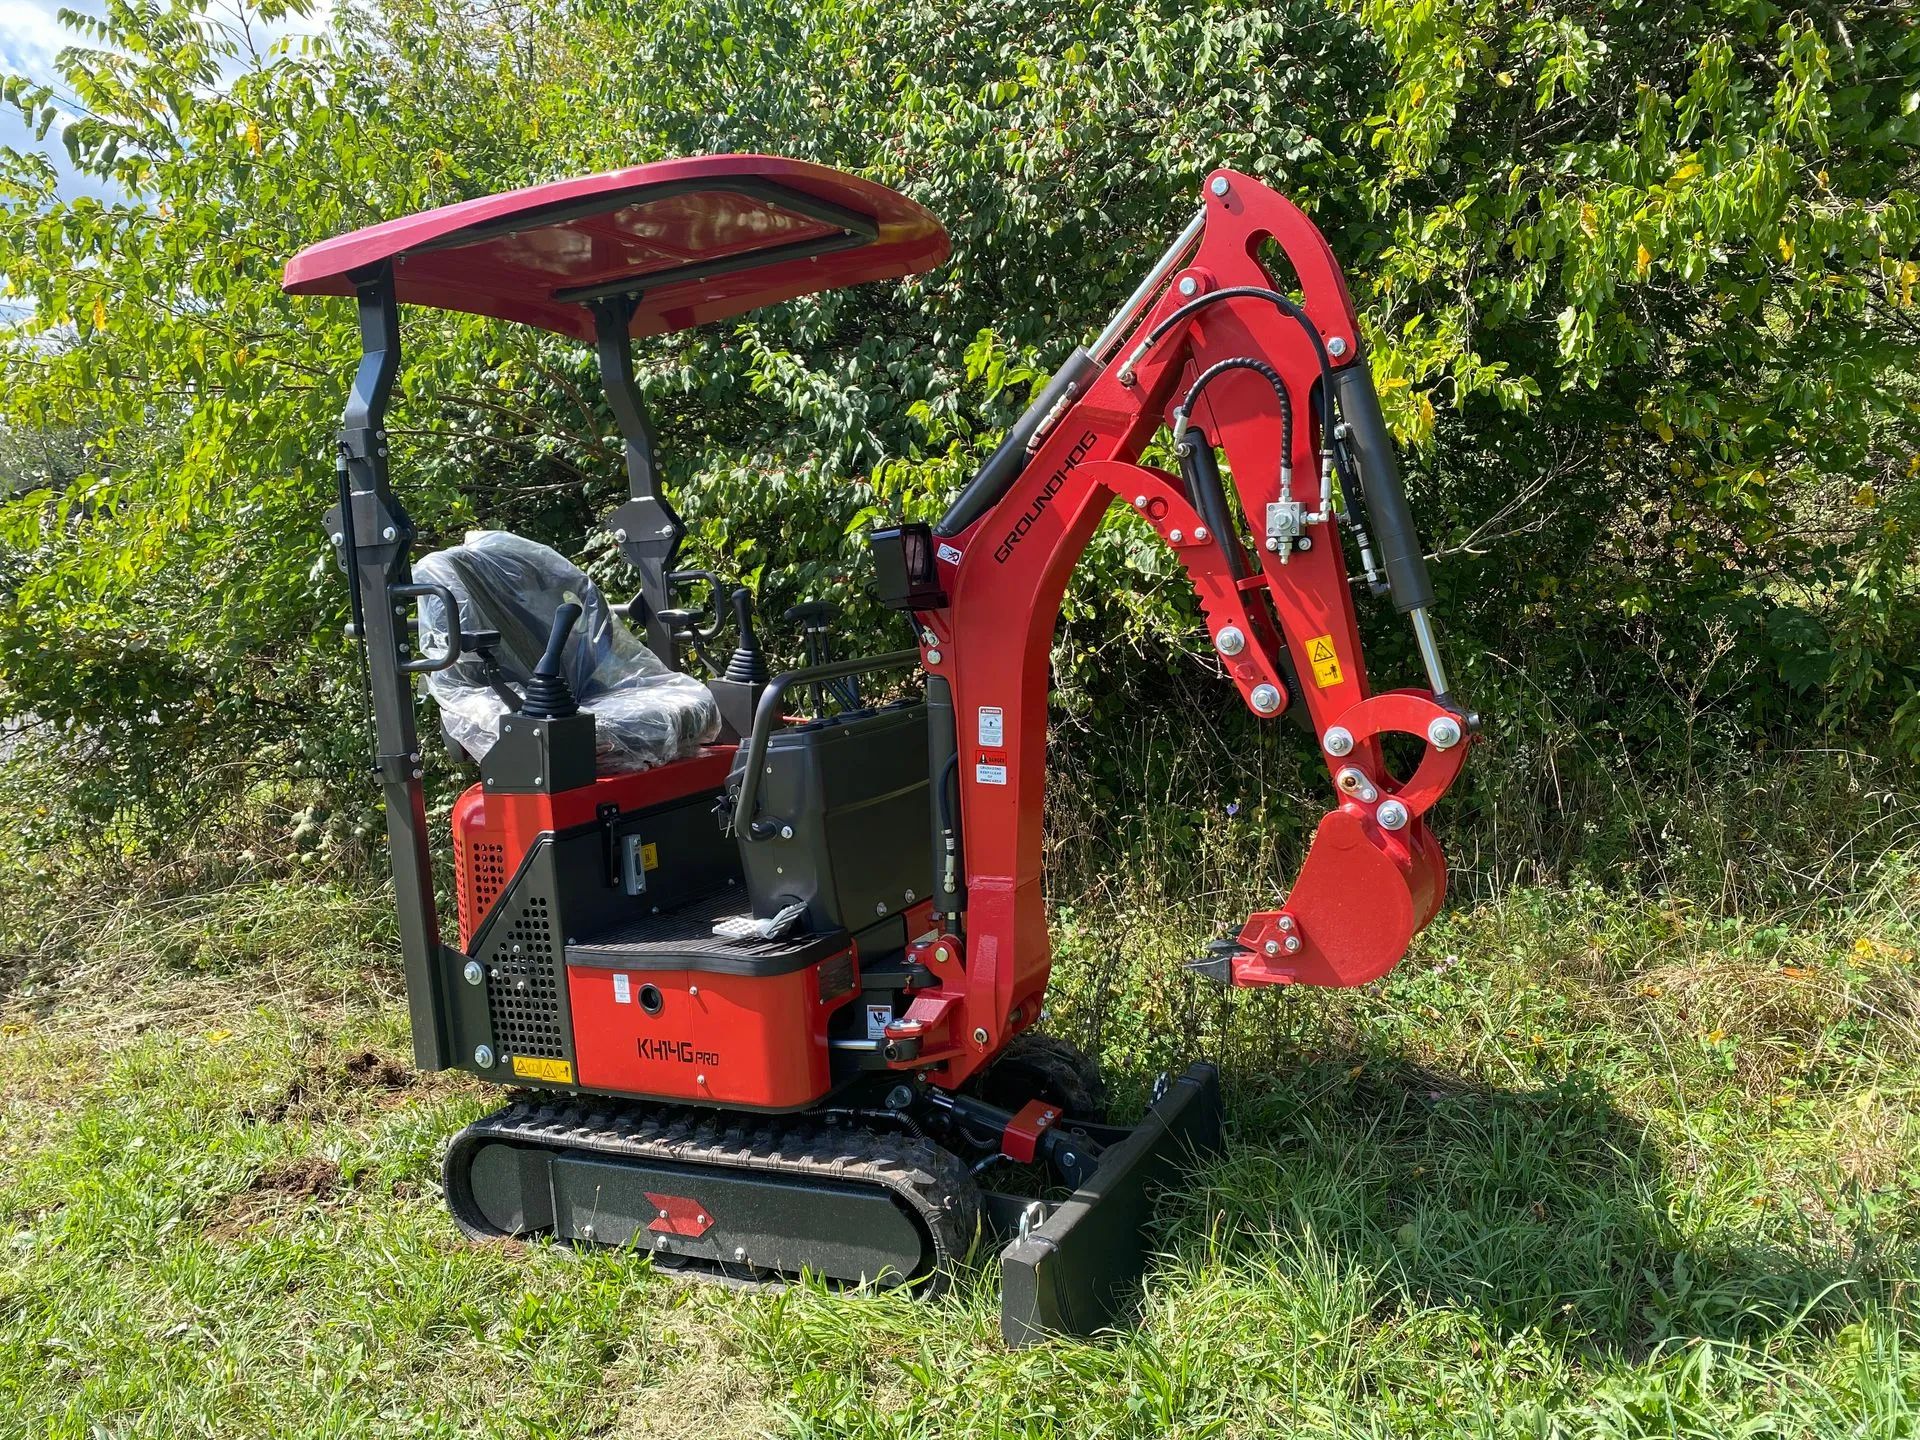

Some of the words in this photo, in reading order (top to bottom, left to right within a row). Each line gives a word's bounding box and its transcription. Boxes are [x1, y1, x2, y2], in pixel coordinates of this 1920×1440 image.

[994, 430, 1098, 564] GROUNDHOG
[637, 1037, 694, 1063] KH14G
[695, 1051, 719, 1066] PRO
